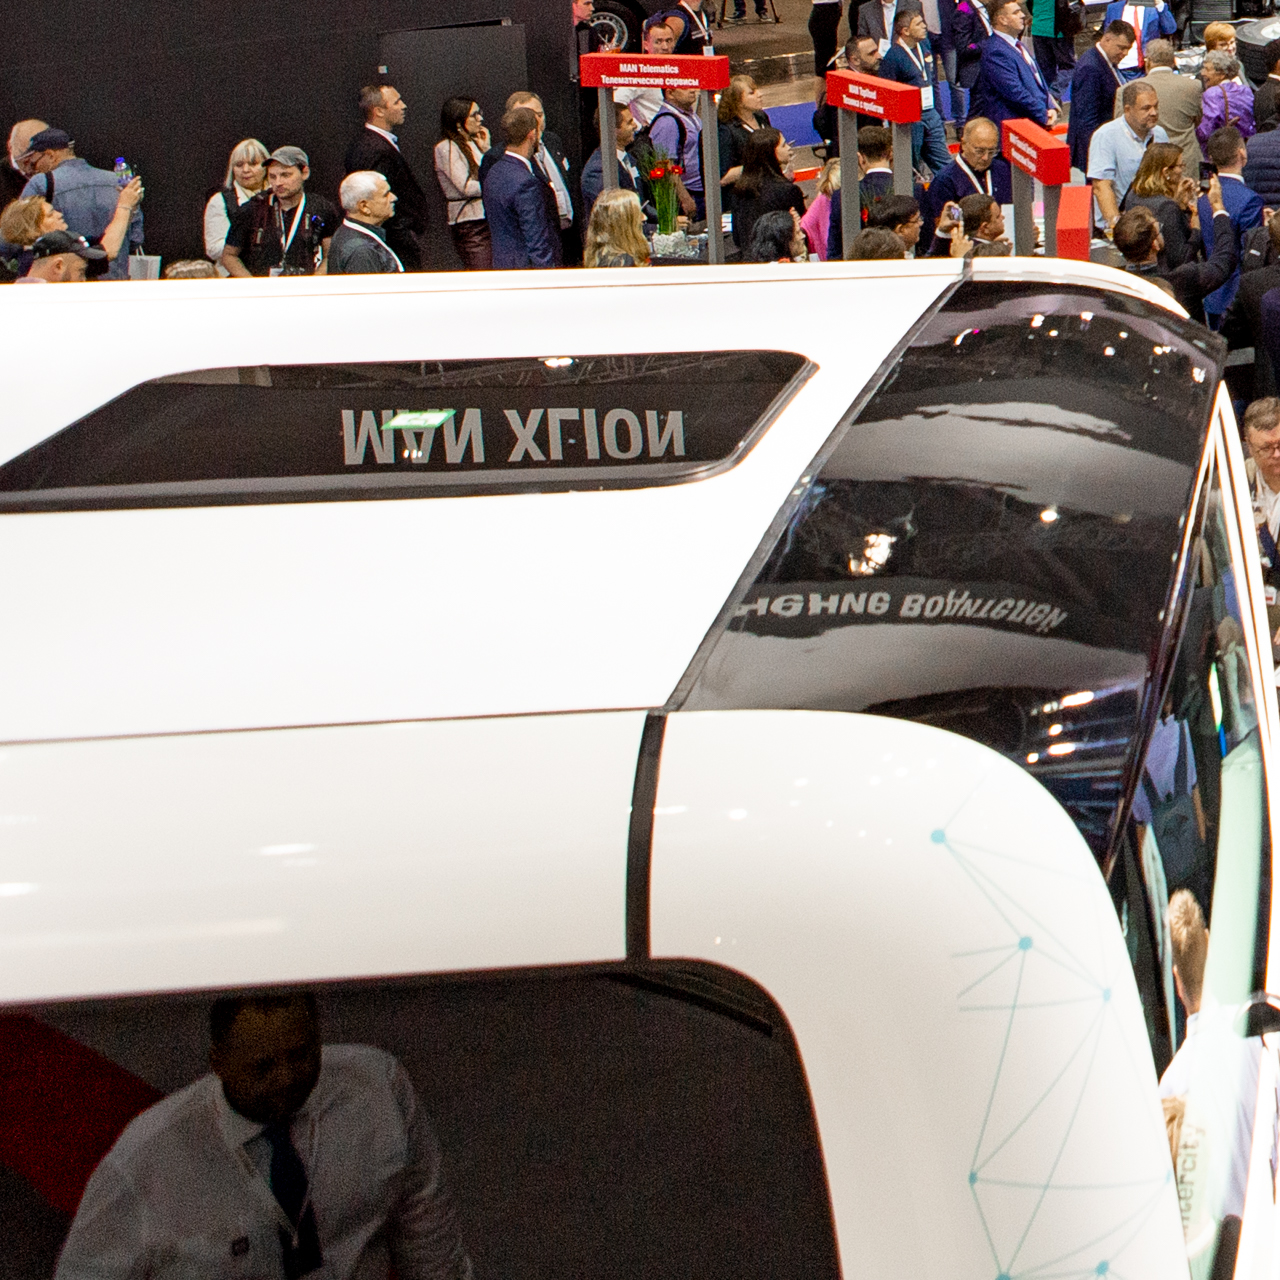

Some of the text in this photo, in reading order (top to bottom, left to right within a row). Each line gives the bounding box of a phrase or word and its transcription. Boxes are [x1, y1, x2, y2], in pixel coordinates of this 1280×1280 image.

[619, 63, 680, 74] MAN Telematics
[601, 75, 699, 87] Телематические сервисы
